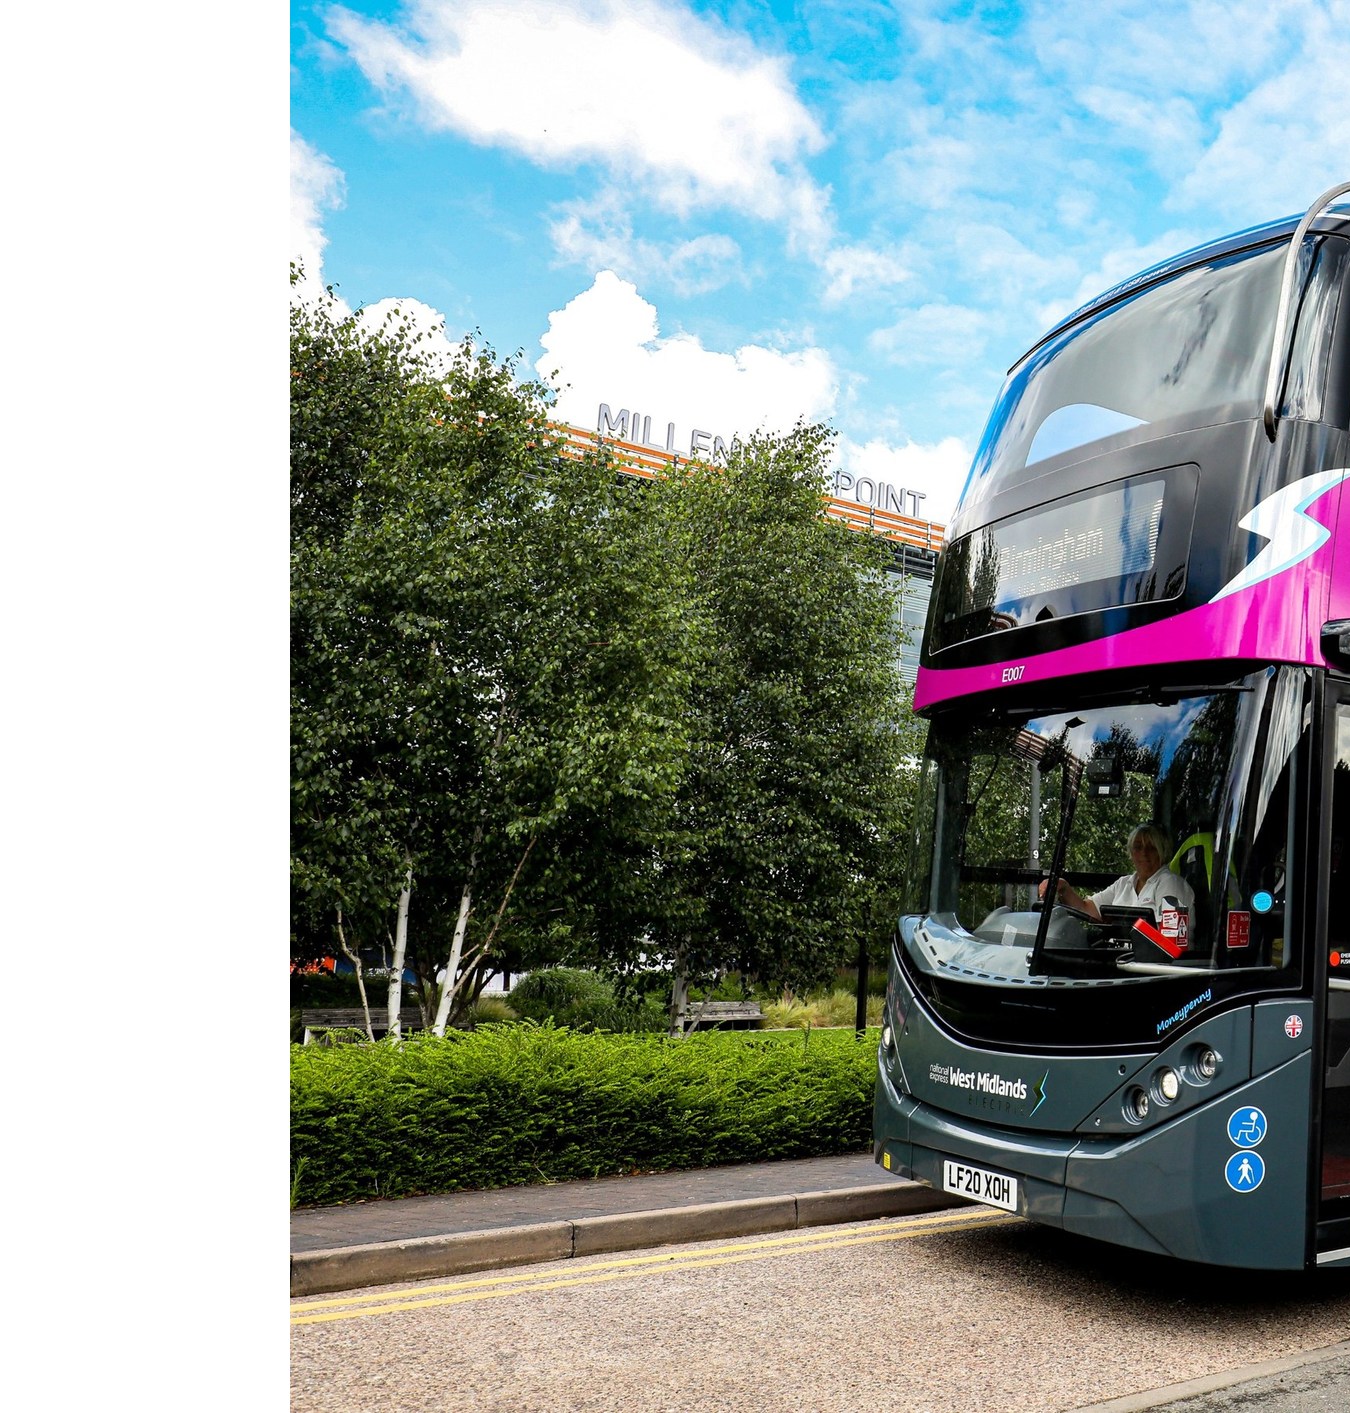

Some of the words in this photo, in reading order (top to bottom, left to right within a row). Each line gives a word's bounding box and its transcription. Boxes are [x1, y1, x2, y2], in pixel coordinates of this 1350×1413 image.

[835, 470, 927, 519] POINT
[999, 528, 1103, 581] Birmingham
[1002, 665, 1025, 683] E007
[1156, 988, 1212, 1034] Moneypenny
[929, 1073, 949, 1084] express
[930, 1062, 950, 1075] national
[950, 1066, 975, 1090] West
[976, 1071, 1028, 1099] Midlands
[949, 1165, 981, 1195] LF20
[984, 1173, 1010, 1204] XOH
